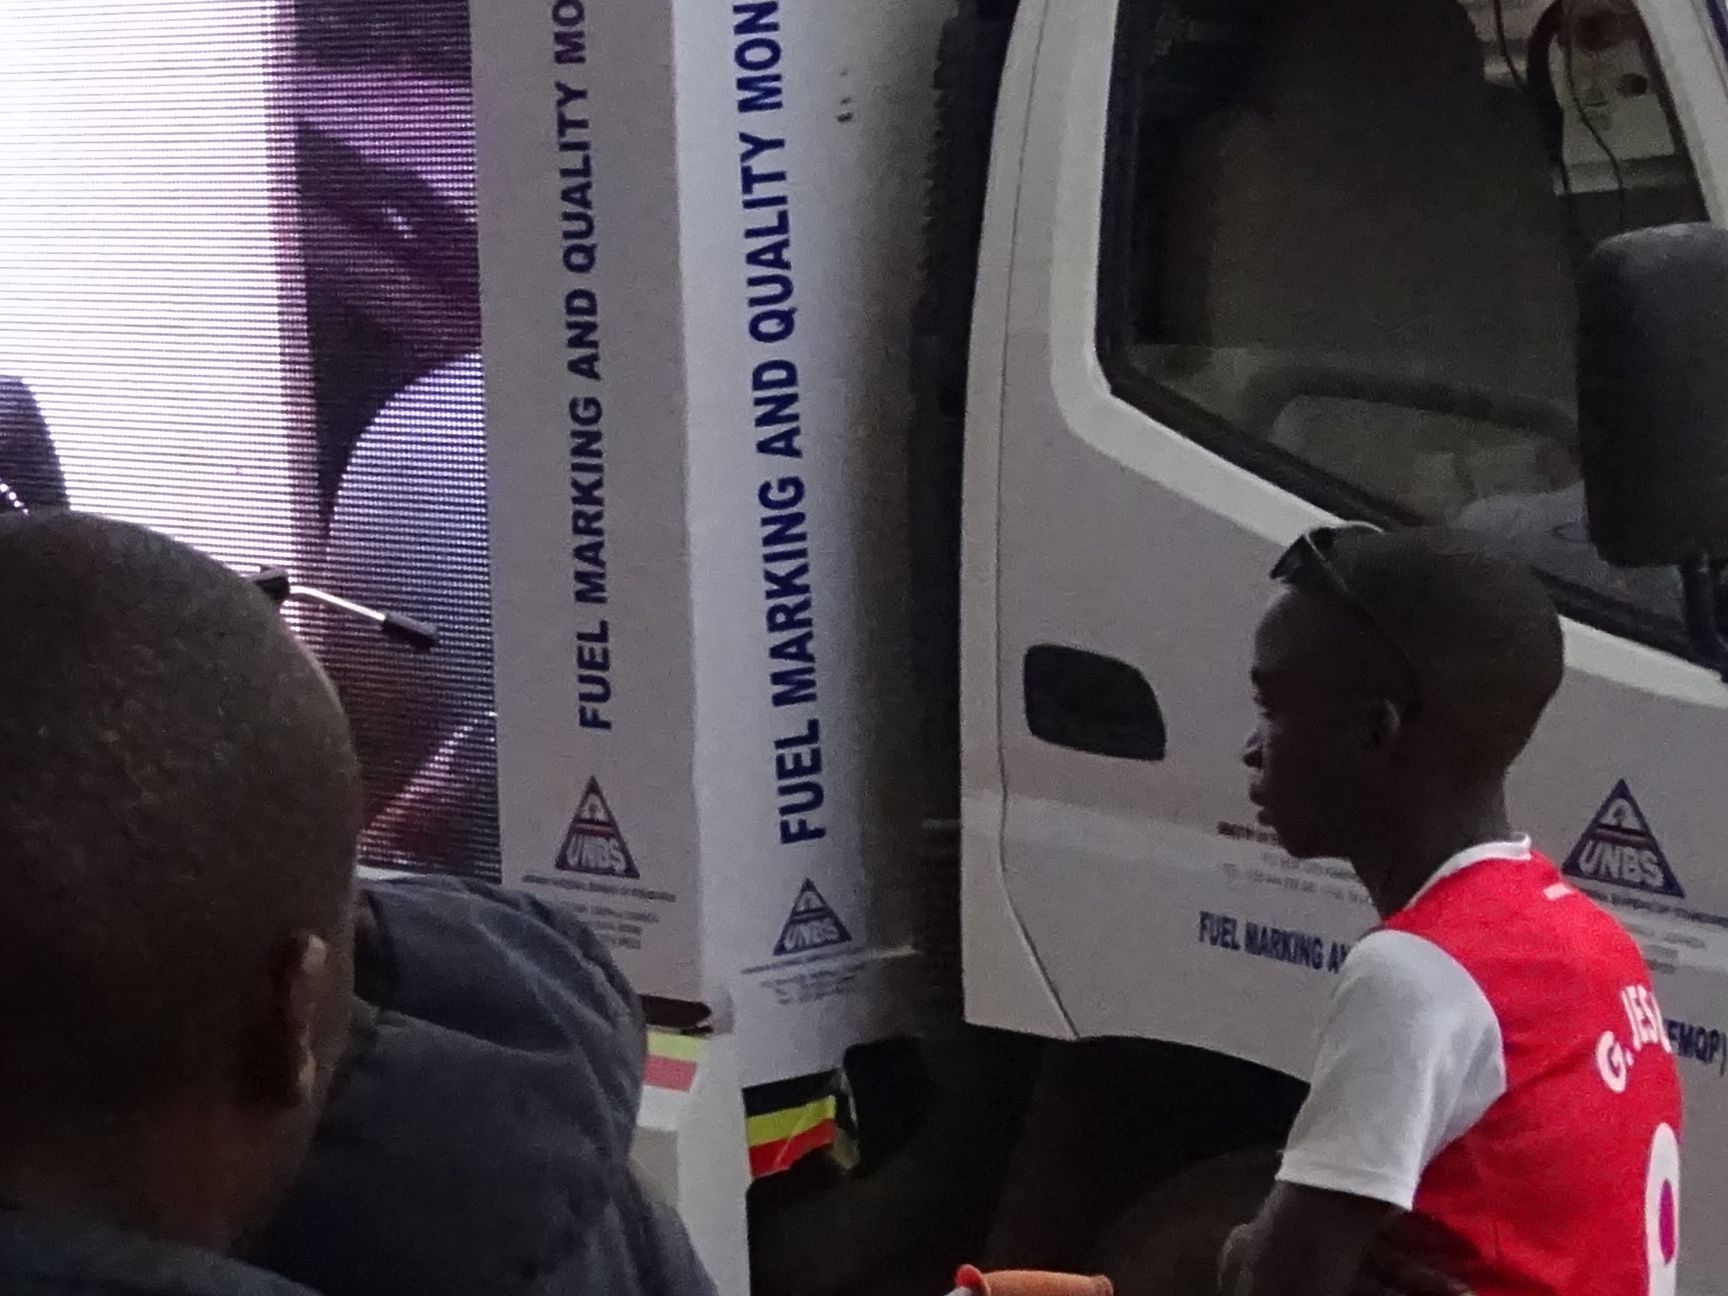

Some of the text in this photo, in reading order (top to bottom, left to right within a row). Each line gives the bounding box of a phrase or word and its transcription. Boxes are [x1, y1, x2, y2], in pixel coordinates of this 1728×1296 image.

[553, 80, 599, 274] QUALITY
[738, 131, 799, 345] QUALITY
[563, 288, 602, 382] AND
[750, 357, 804, 460] AND
[568, 395, 610, 605] MARKING
[757, 475, 819, 708] MARKING
[575, 619, 613, 732] FUEL
[773, 718, 827, 846] FUEL
[1578, 839, 1665, 888] UNBS
[1198, 910, 1241, 952] FUEL
[1244, 920, 1324, 971] MARKING
